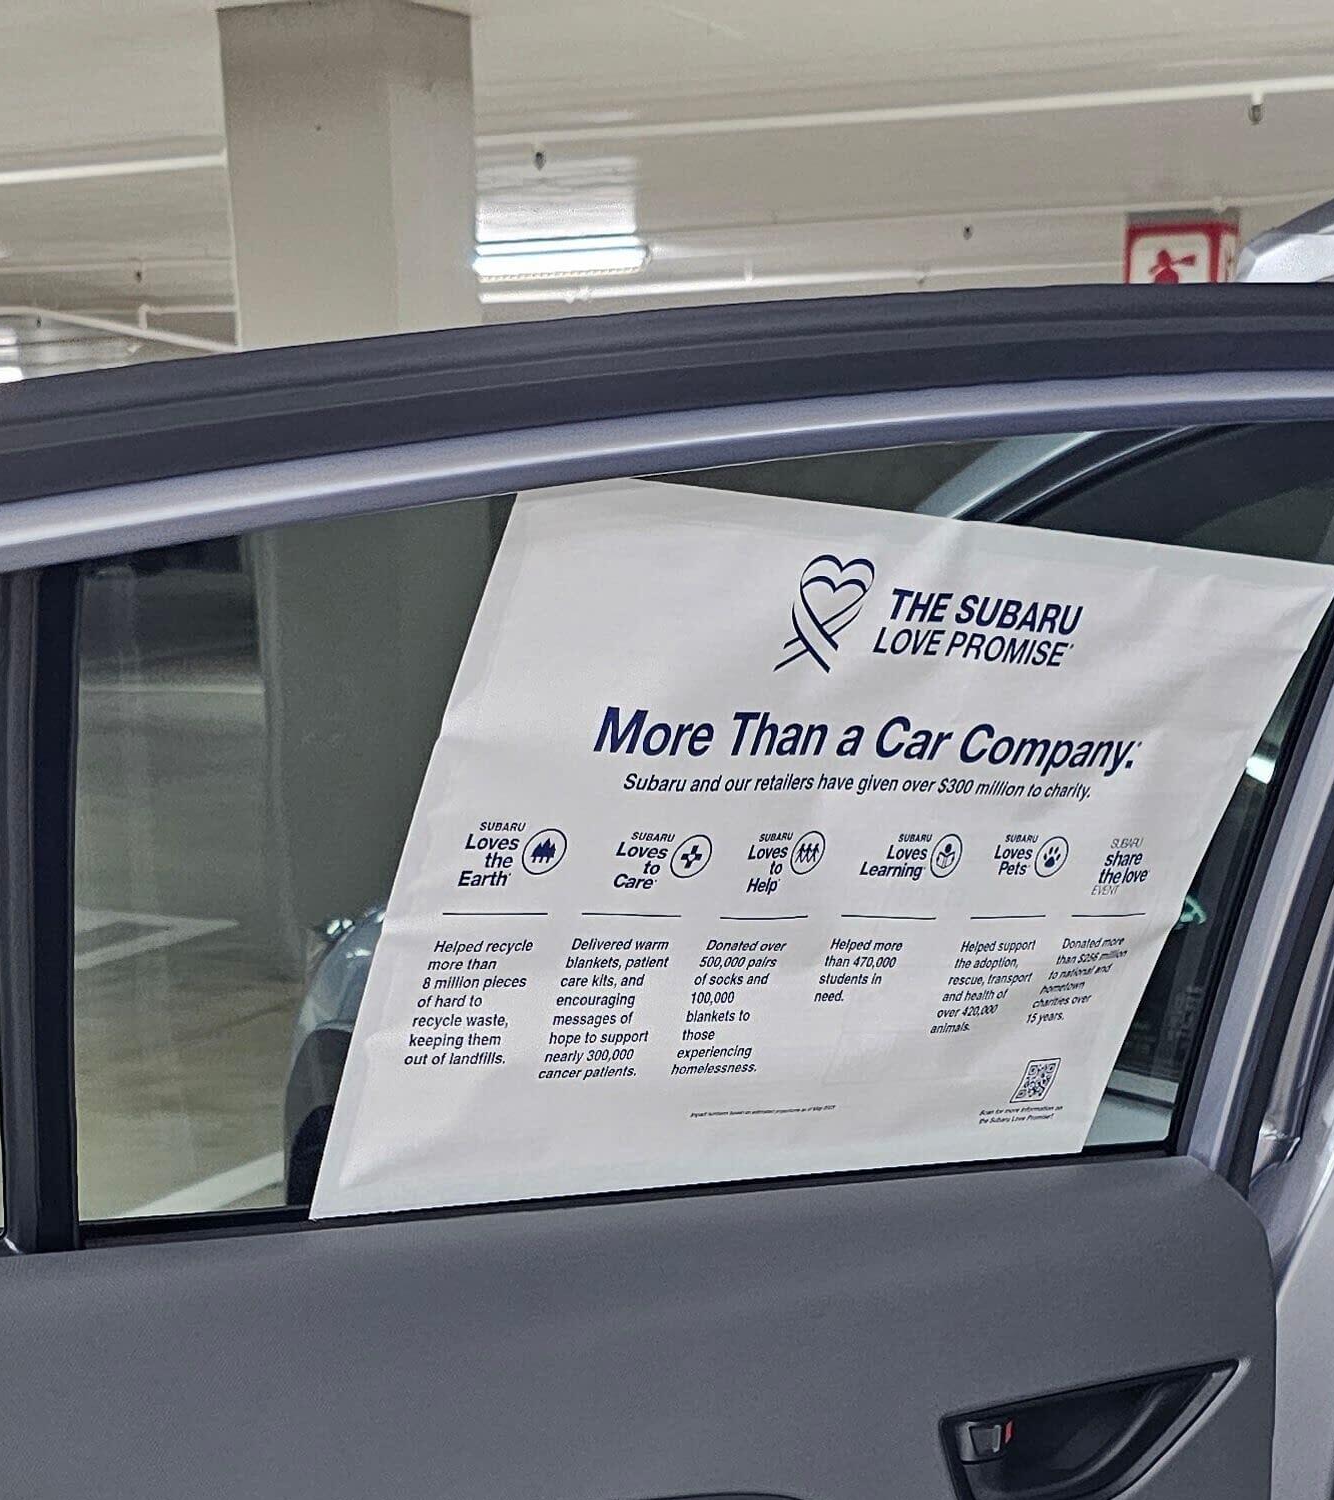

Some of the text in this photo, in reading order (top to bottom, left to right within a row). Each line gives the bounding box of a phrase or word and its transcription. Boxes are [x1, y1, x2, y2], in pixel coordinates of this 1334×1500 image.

[890, 588, 1084, 635] THE SUBARU
[872, 627, 946, 656] LOVE
[593, 706, 714, 757] More
[731, 712, 828, 756] Than
[836, 725, 863, 757] a
[876, 716, 954, 761] Car
[623, 773, 1091, 802] Subaru and our retailers have given over $300 million to charity.
[479, 821, 526, 832] SUBARU
[464, 833, 520, 850] Loves
[631, 831, 676, 842] SUBARU
[759, 832, 794, 842] SUBARU
[898, 833, 933, 843] SUBARU
[1005, 834, 1039, 843] SUBARU
[615, 841, 669, 859] Loves
[747, 844, 789, 860] Loves
[886, 844, 928, 860] Loves
[994, 844, 1033, 860] Loves
[485, 851, 513, 868] the
[1104, 850, 1143, 867] share
[643, 860, 661, 875] to
[769, 860, 783, 875] to
[1098, 867, 1122, 884] the
[433, 939, 533, 956] Helped recycle
[571, 938, 669, 950] Delivered warm
[706, 939, 787, 951] Donated over
[830, 938, 903, 953] Helped more
[960, 939, 1036, 955] Helped support
[427, 958, 497, 970] more than
[565, 956, 669, 971] blankets, patient
[699, 956, 778, 970] 500,000 pairs
[824, 955, 897, 970] than 470,000
[954, 956, 1018, 971] the adoption,
[422, 975, 527, 991] 8 million pieces
[560, 973, 645, 989] care kits, and
[694, 972, 770, 986] of socks and
[819, 972, 882, 985] students in
[948, 972, 1033, 986] rescue, transport
[417, 994, 482, 1008] of hard to
[556, 992, 635, 1009] encouraging
[691, 991, 735, 1006] 100,000
[814, 989, 844, 1002] need.
[942, 988, 1009, 1002] and health of
[552, 1011, 634, 1028] messages of
[686, 1009, 751, 1023] blankets to
[937, 1008, 961, 1018] over
[412, 1013, 508, 1030] recycle waste,
[930, 1021, 970, 1034] animals.
[409, 1033, 501, 1050] keeping them
[548, 1030, 649, 1048] hope to support
[682, 1029, 715, 1041] those
[404, 1052, 505, 1065] out of landfills.
[544, 1048, 634, 1065] nearly 300,000
[677, 1045, 752, 1061] experiencing
[538, 1066, 636, 1081] cancer patients.
[671, 1062, 757, 1075] homelessness.
